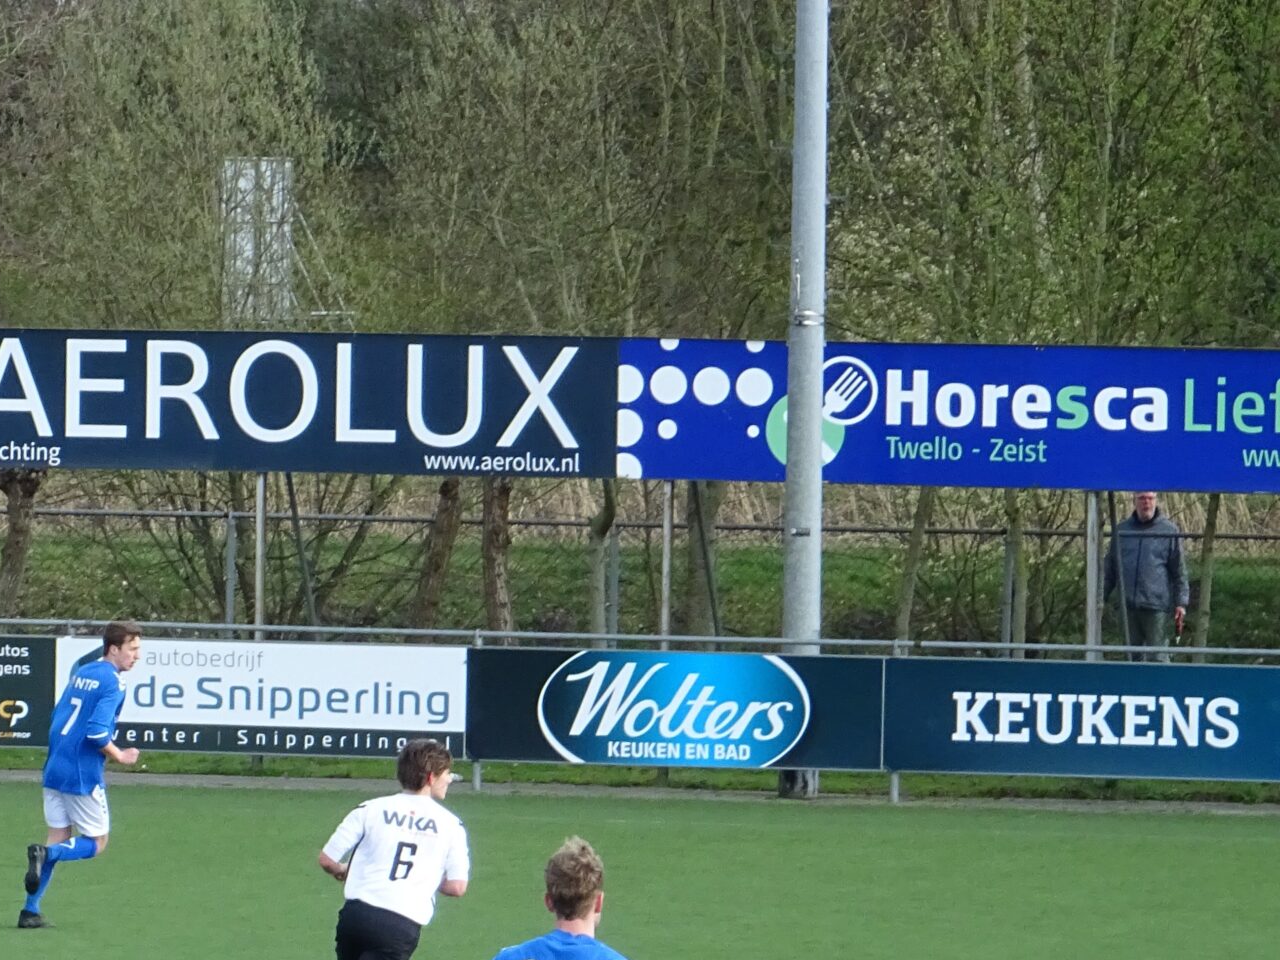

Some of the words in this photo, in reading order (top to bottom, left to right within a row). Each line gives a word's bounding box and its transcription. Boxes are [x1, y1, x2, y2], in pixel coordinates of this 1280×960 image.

[884, 368, 1169, 433] Horesca
[423, 450, 581, 474] www.aerolux.nl
[886, 434, 962, 462] Twello
[989, 436, 1048, 465] Zeist
[146, 649, 265, 672] autobedrijf
[74, 676, 100, 692] NTP
[134, 675, 184, 709] de
[197, 676, 451, 724] Snipperling
[566, 660, 794, 742] Wolters
[60, 696, 83, 736] 7
[951, 691, 1240, 749] KEUKENS
[111, 727, 200, 744] venter
[608, 741, 681, 760] KEUKEN
[685, 743, 711, 760] EN
[714, 743, 751, 761] BAD
[389, 841, 418, 882] 6
